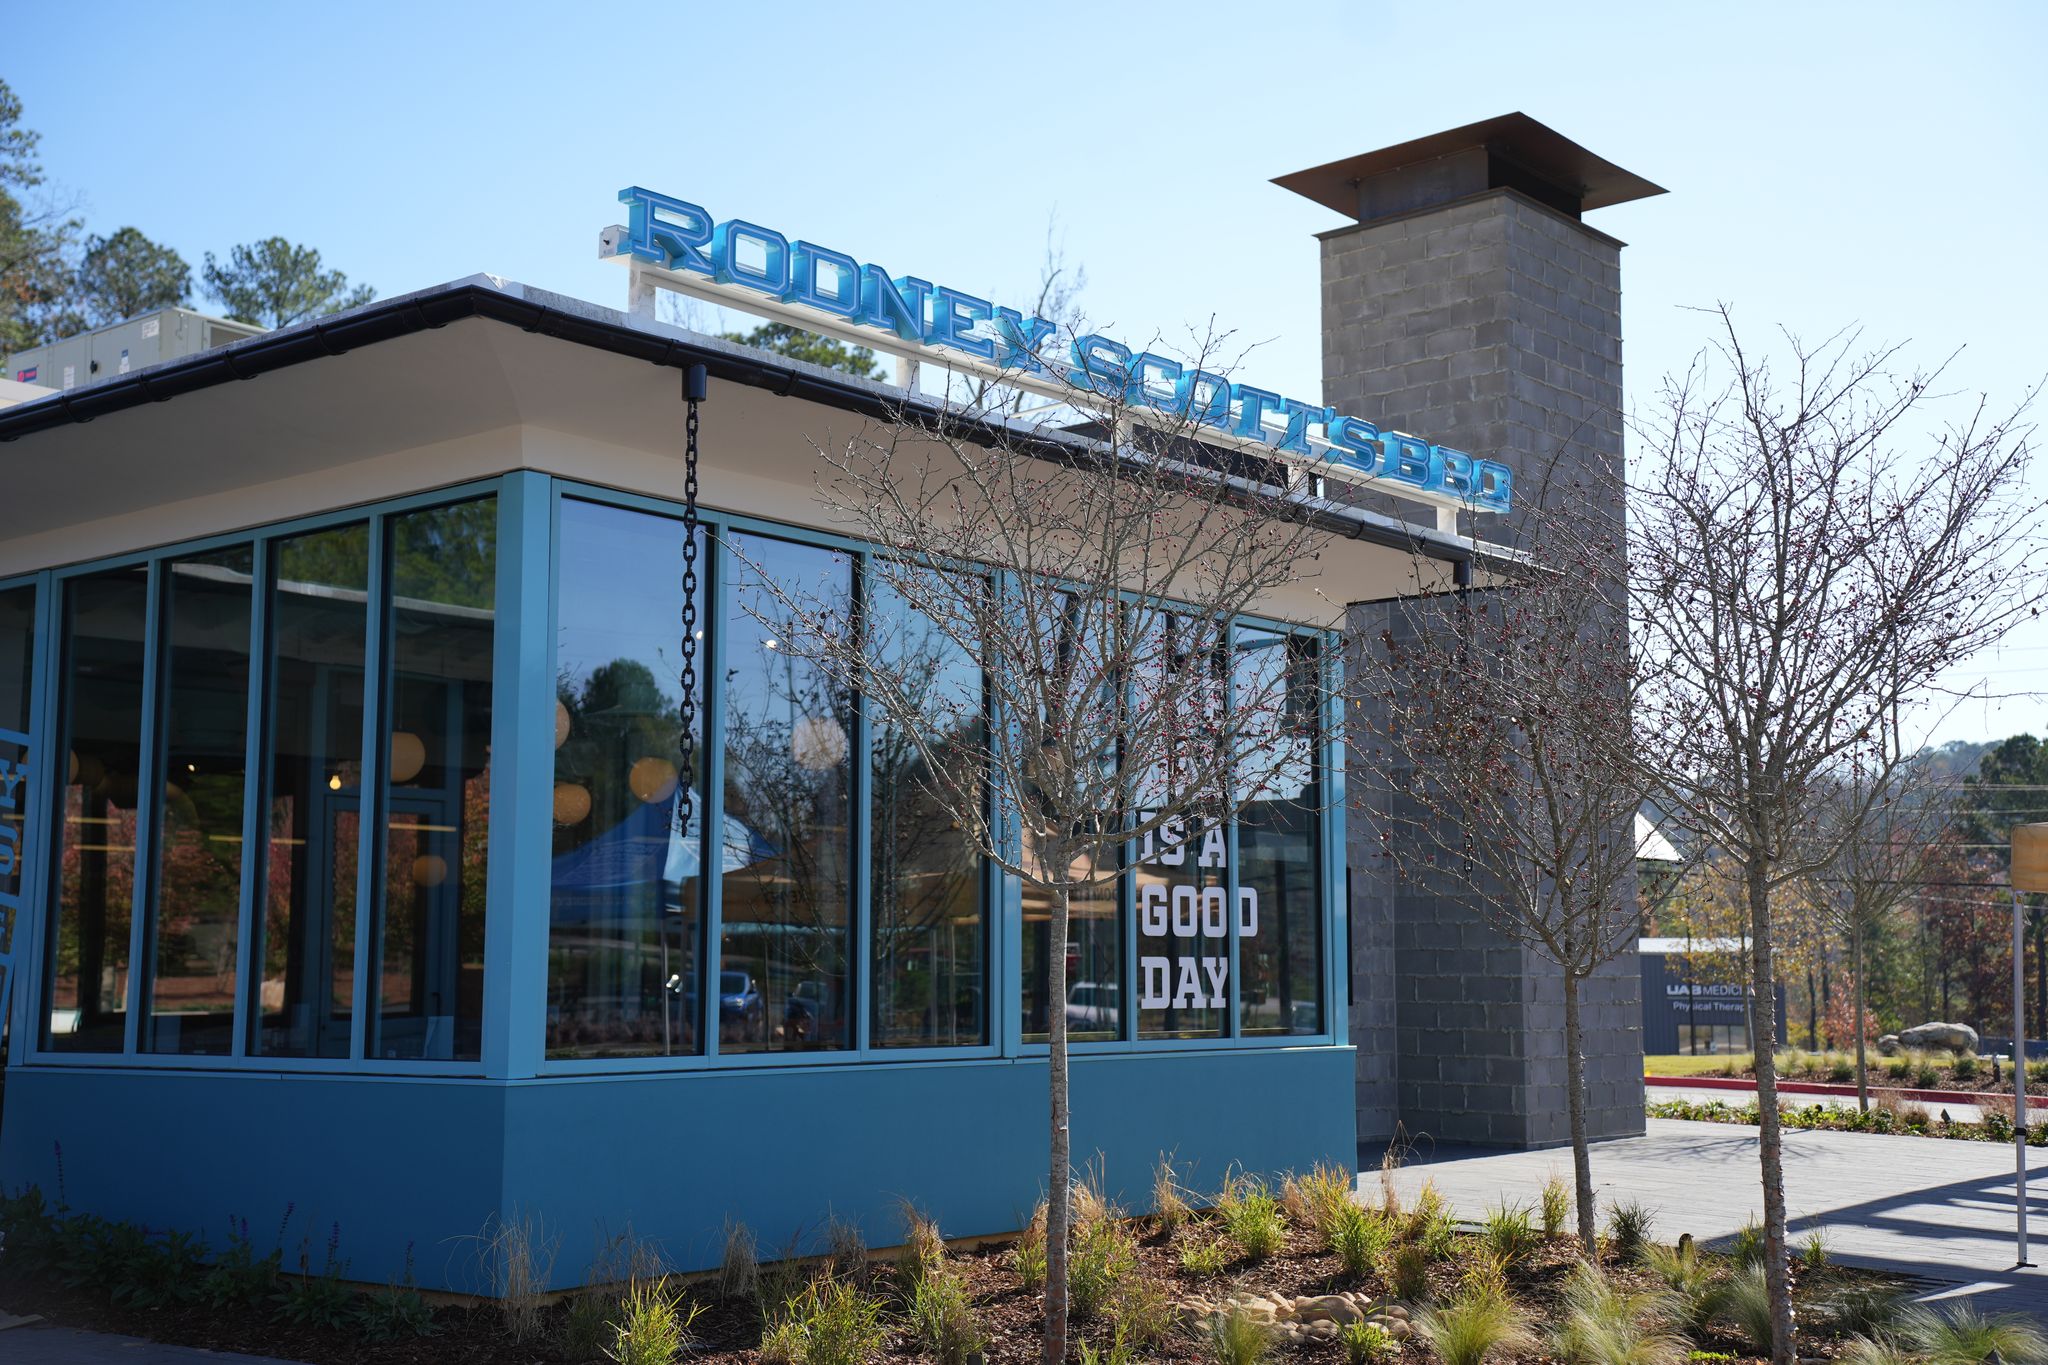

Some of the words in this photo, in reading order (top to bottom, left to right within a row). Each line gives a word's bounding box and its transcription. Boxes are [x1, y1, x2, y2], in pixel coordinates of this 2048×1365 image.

[618, 186, 1056, 373] RODNEY
[1071, 334, 1380, 472] SCOTT'S
[1382, 430, 1512, 513] BBQ
[1140, 812, 1185, 866] IS
[1198, 815, 1227, 868] A
[1141, 884, 1258, 938] GOOD
[1140, 956, 1229, 1010] DAY
[1666, 984, 1702, 996] UAB
[1702, 984, 1753, 996] MEDICI
